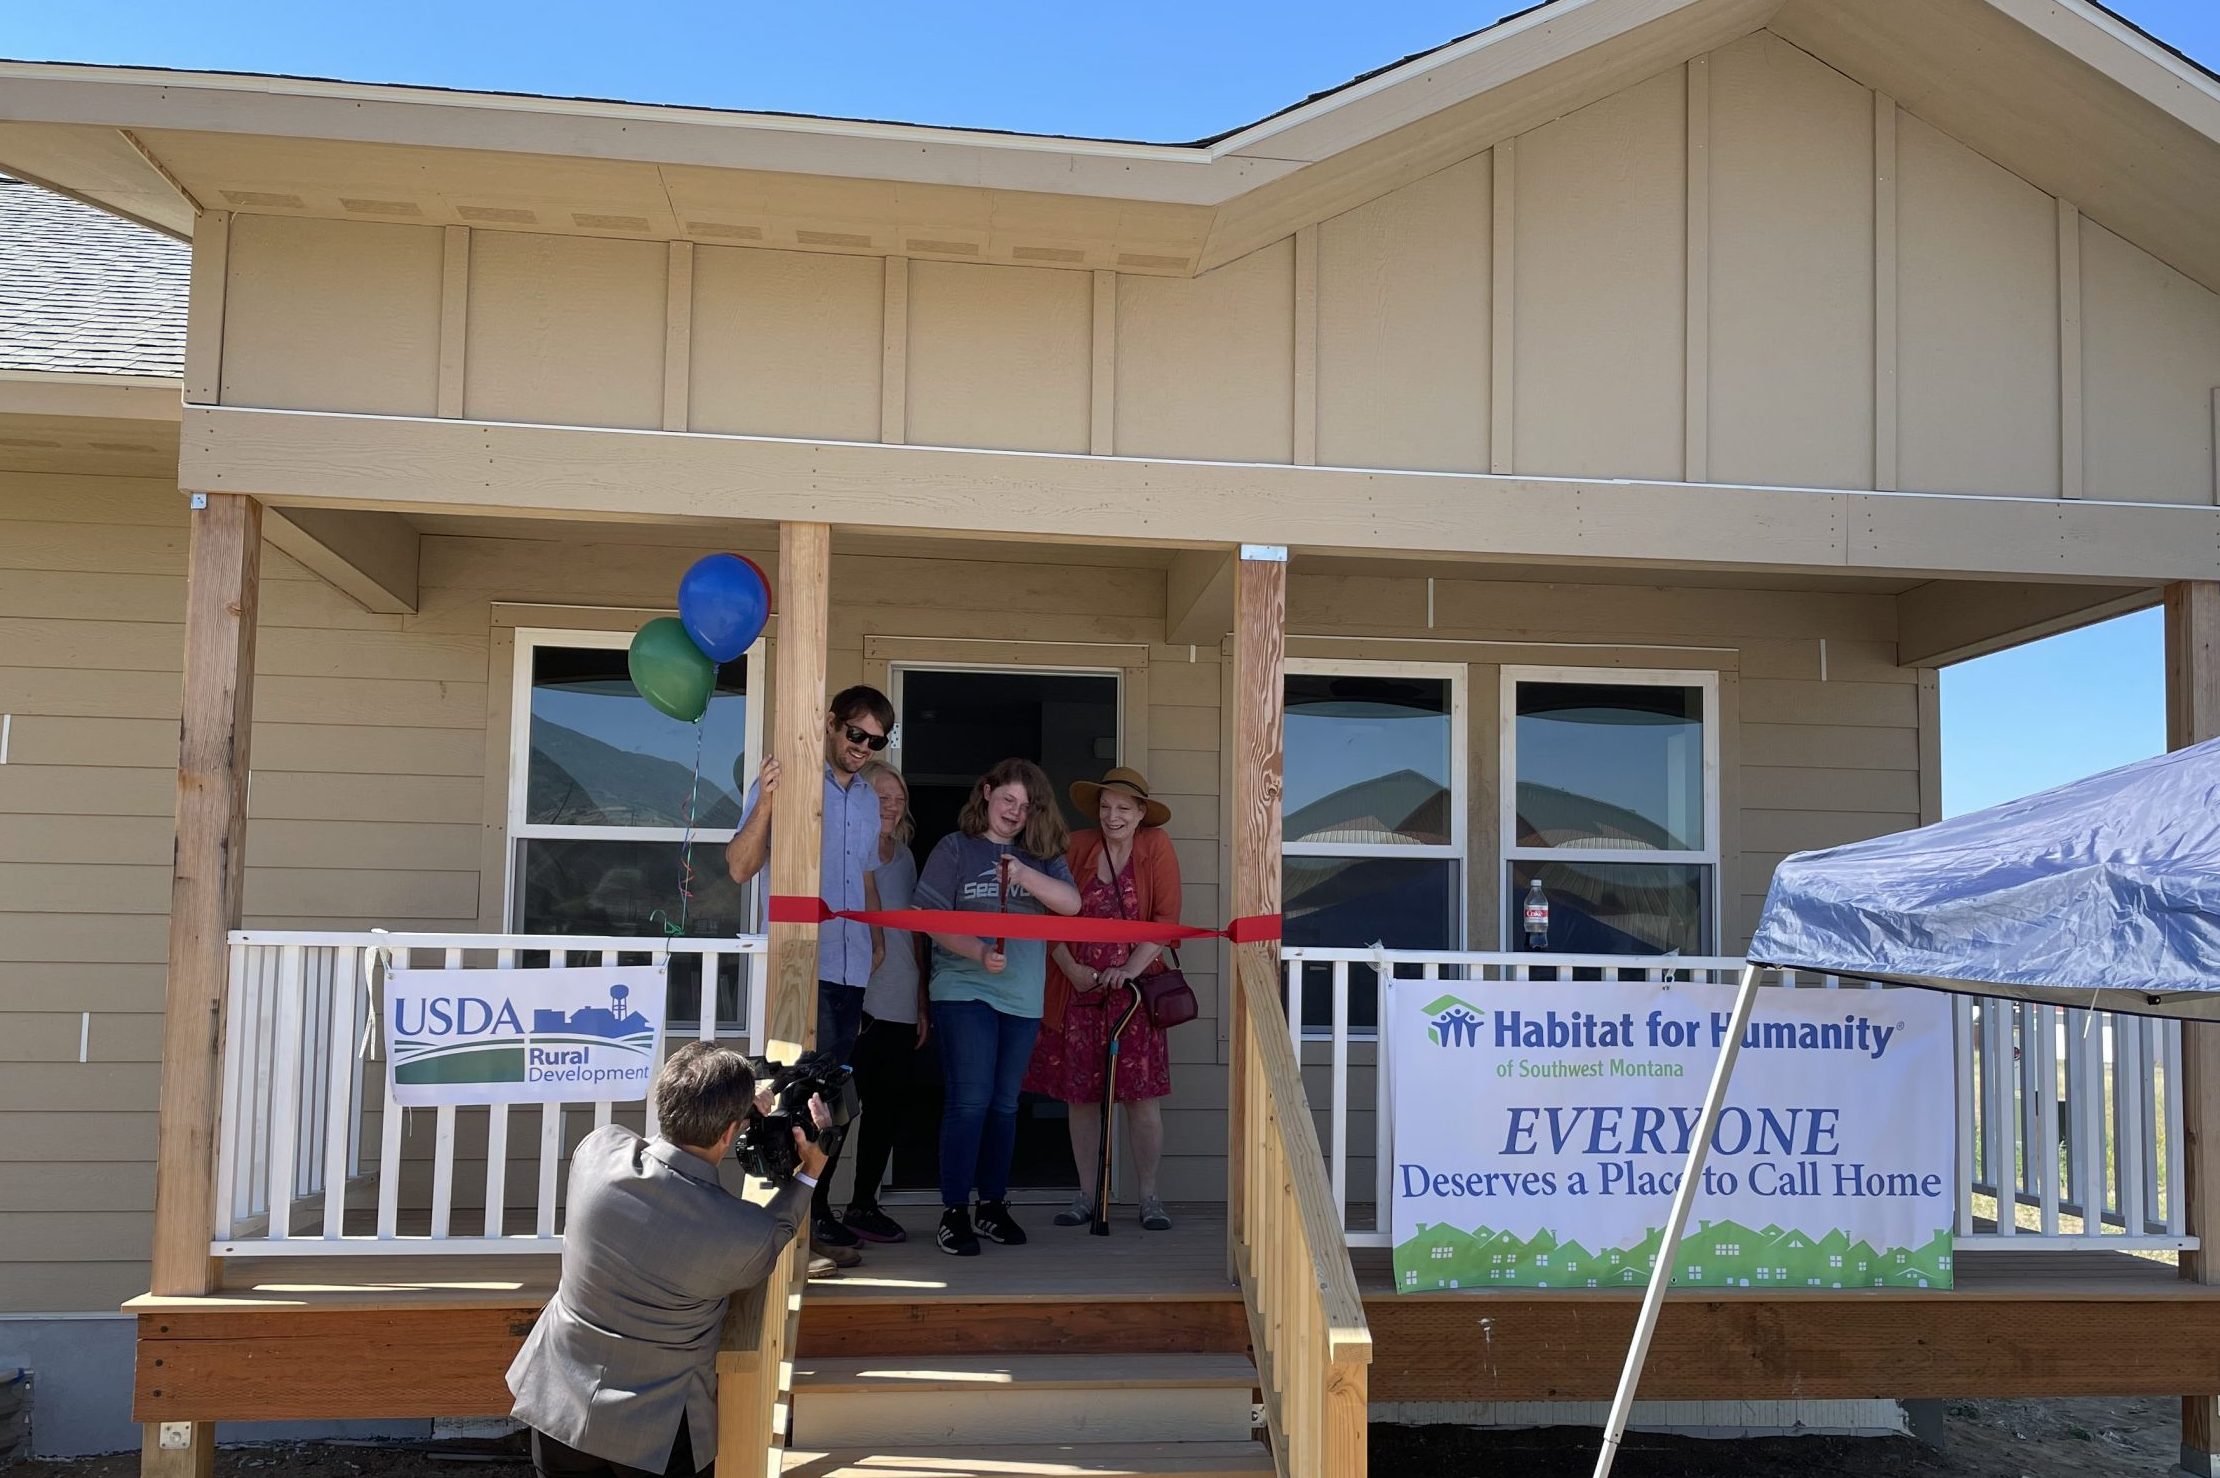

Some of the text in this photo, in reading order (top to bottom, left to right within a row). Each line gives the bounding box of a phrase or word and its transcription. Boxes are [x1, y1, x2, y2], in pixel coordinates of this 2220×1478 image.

[395, 997, 526, 1036] USDA
[1494, 1010, 1634, 1049] Habitat
[1646, 1010, 1700, 1048] for
[529, 1046, 589, 1066] Rural
[1496, 1058, 1684, 1078] of Southwest Montana
[529, 1066, 649, 1084] Development
[1498, 1106, 1840, 1156] EVERYONE
[1400, 1163, 1557, 1198] Deserves
[1567, 1171, 1589, 1196] a
[1702, 1165, 1738, 1196] to
[1748, 1161, 1821, 1196] Call
[1831, 1163, 1942, 1198] Home
